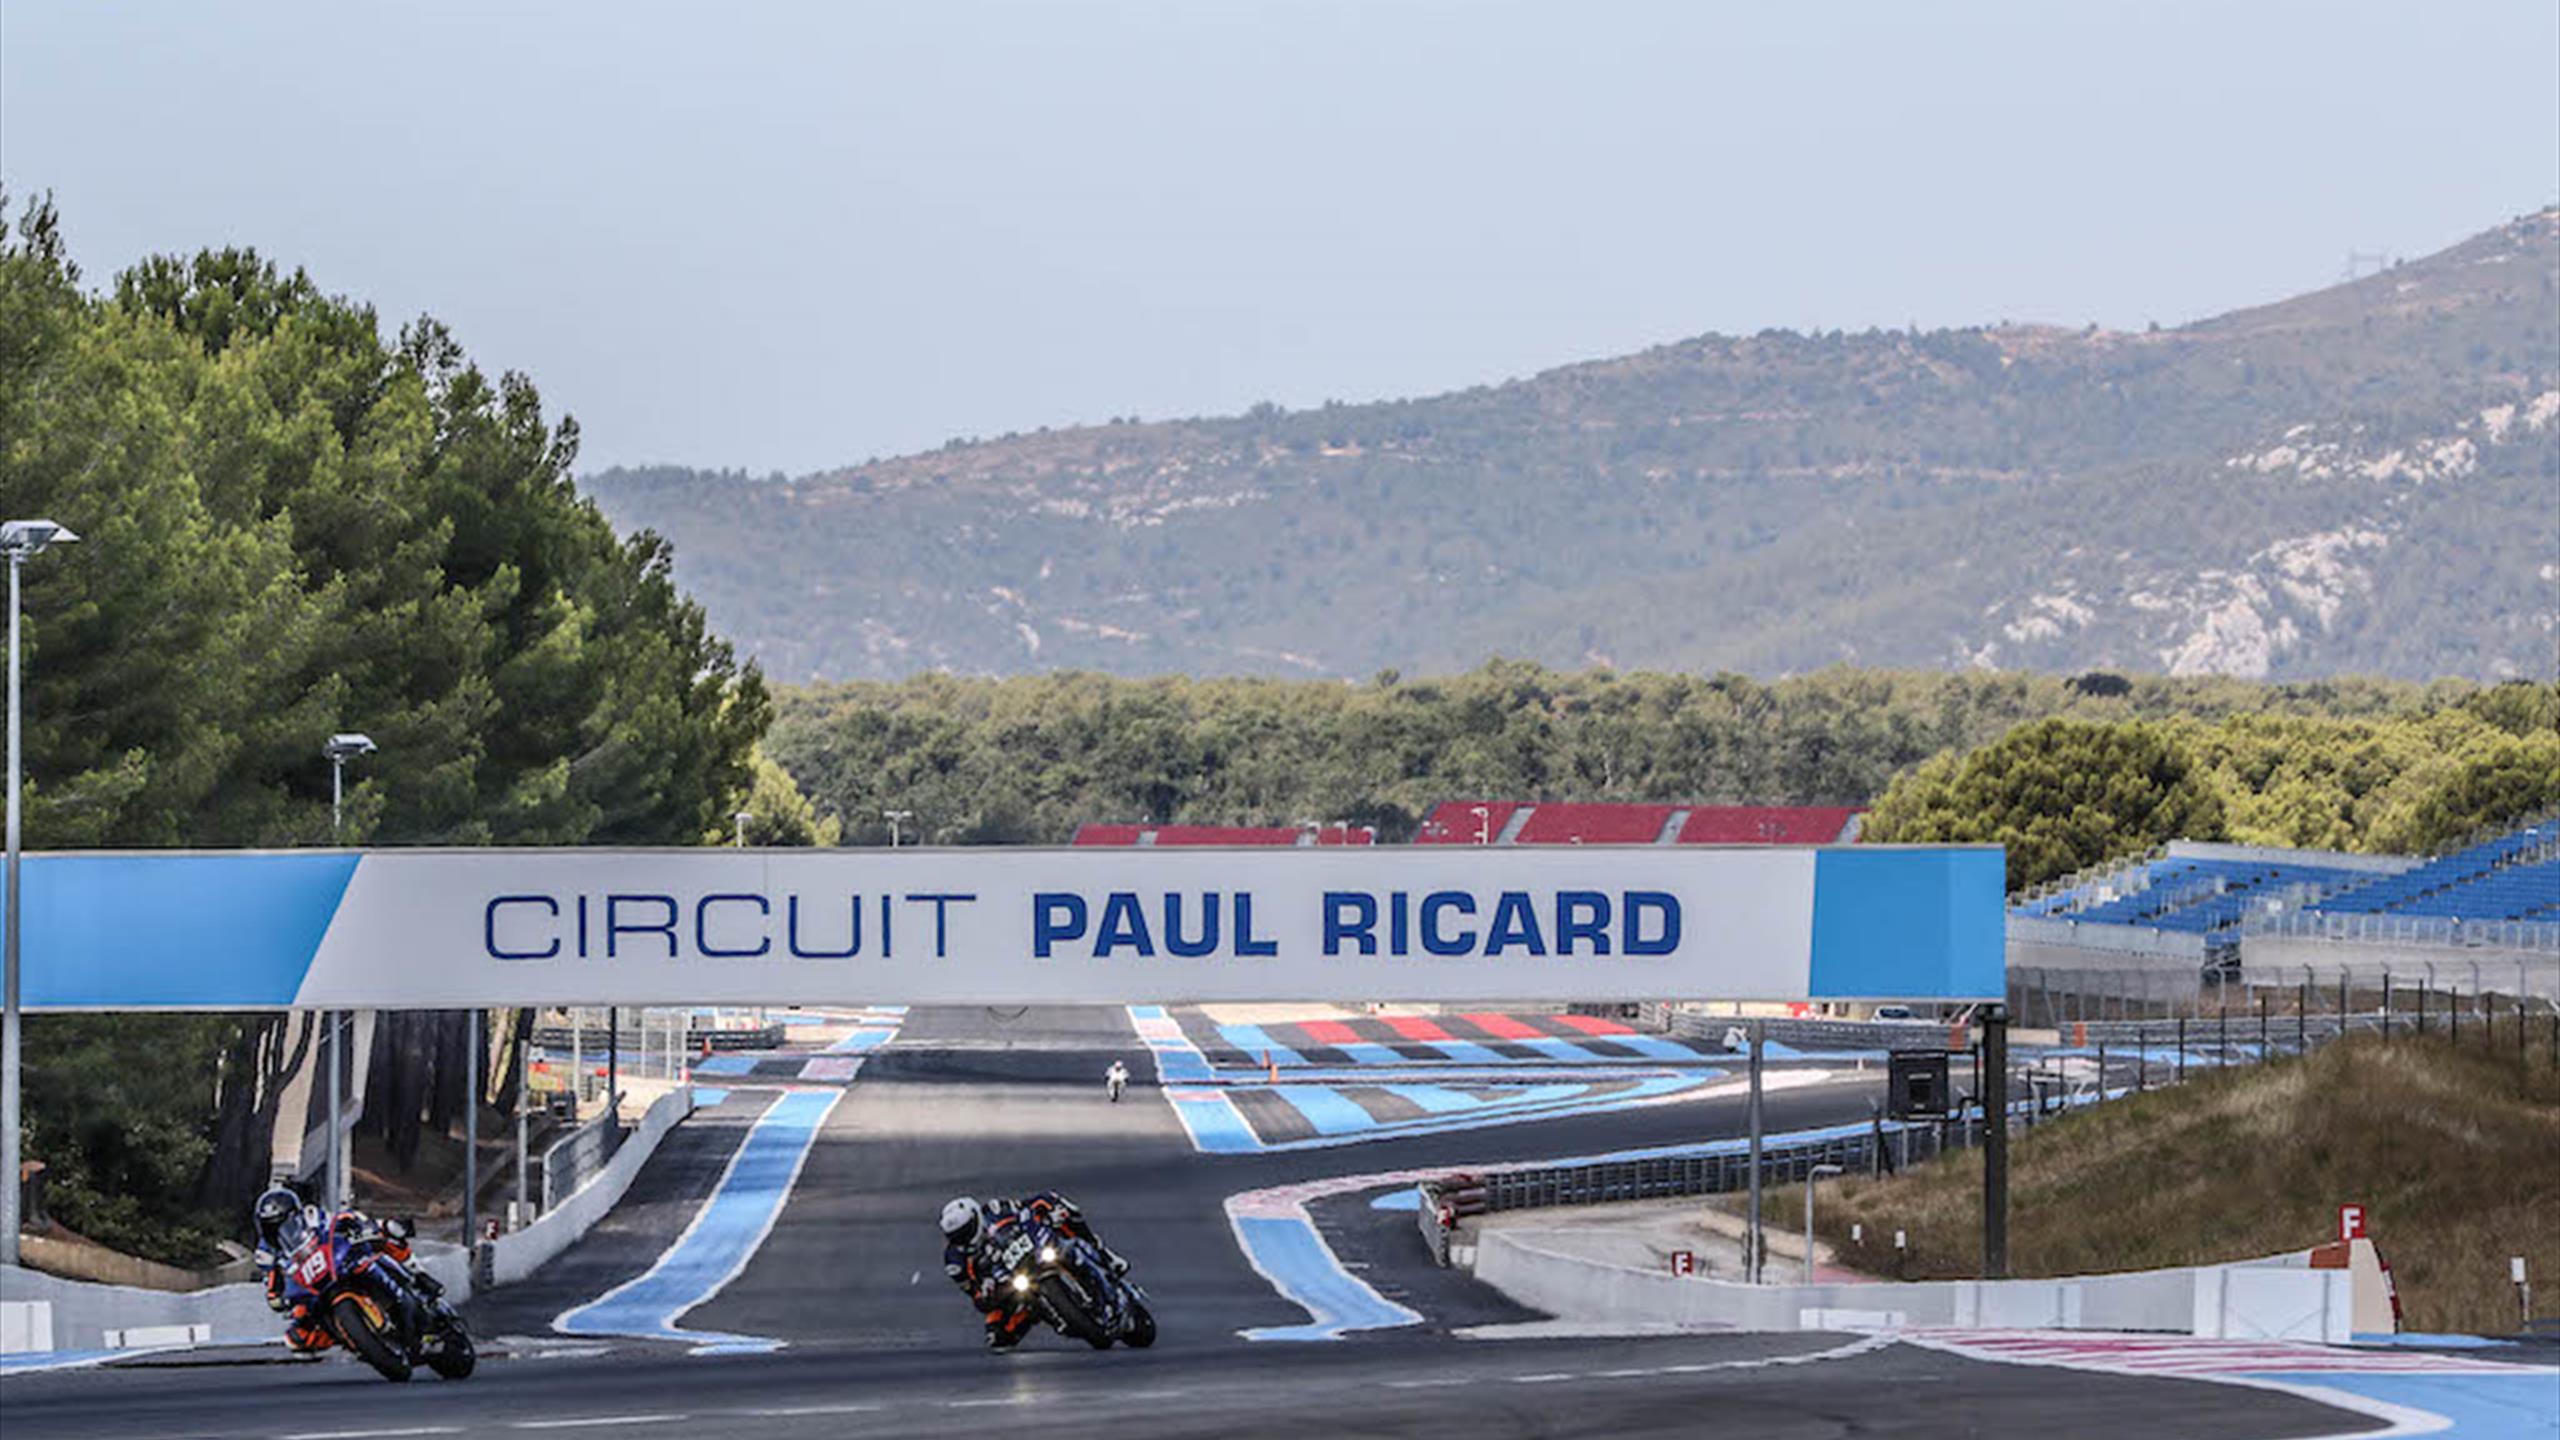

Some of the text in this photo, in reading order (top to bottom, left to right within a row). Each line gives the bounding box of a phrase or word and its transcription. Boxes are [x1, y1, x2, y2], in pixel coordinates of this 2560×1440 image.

[484, 890, 1682, 960] CIRCUIT PAUL RICARD
[2342, 1208, 2360, 1239] F
[301, 1249, 327, 1285] 119
[1675, 1254, 1688, 1275] F
